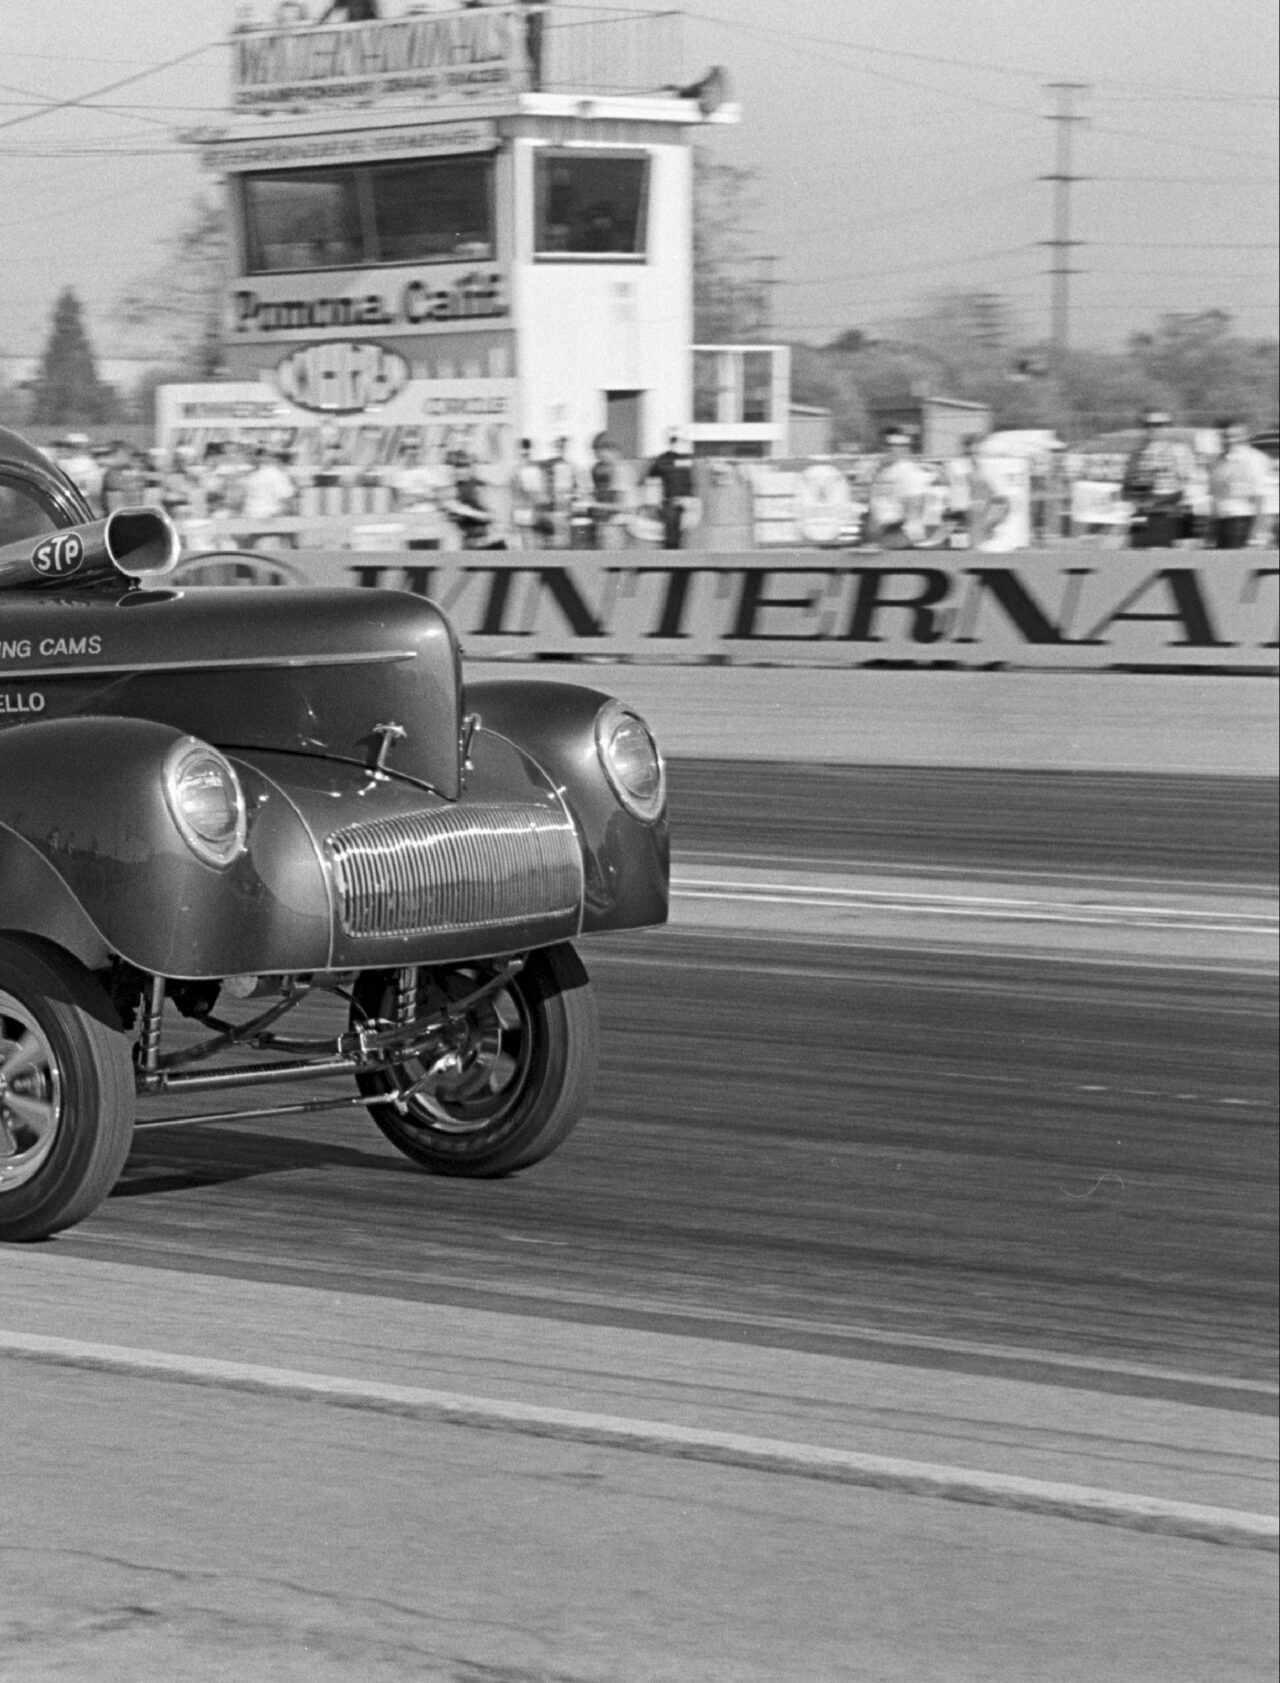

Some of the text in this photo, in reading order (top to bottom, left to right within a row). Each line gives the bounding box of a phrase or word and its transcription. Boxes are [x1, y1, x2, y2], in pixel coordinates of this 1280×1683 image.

[36, 535, 80, 571] STP
[348, 565, 1280, 650] WINTERNA
[39, 634, 103, 655] CAMS
